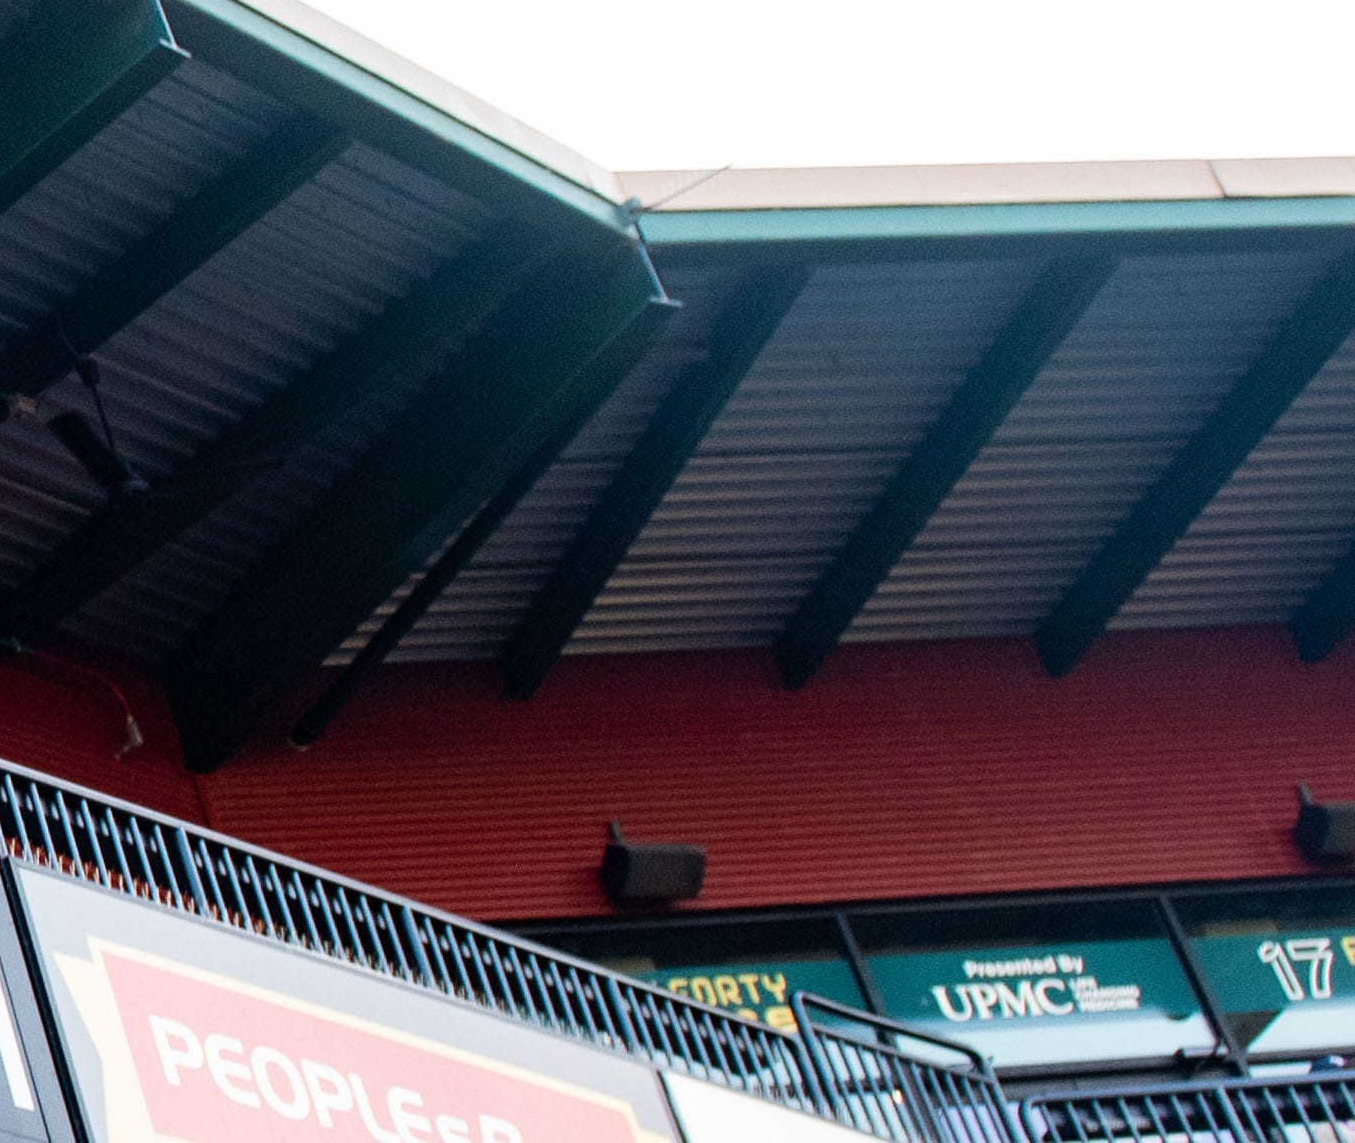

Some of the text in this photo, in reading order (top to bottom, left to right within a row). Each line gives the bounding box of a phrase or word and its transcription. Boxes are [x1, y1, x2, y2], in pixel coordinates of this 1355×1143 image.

[962, 954, 1083, 979] Presented By
[1256, 938, 1333, 1001] 17
[932, 977, 1073, 1022] UPMC
